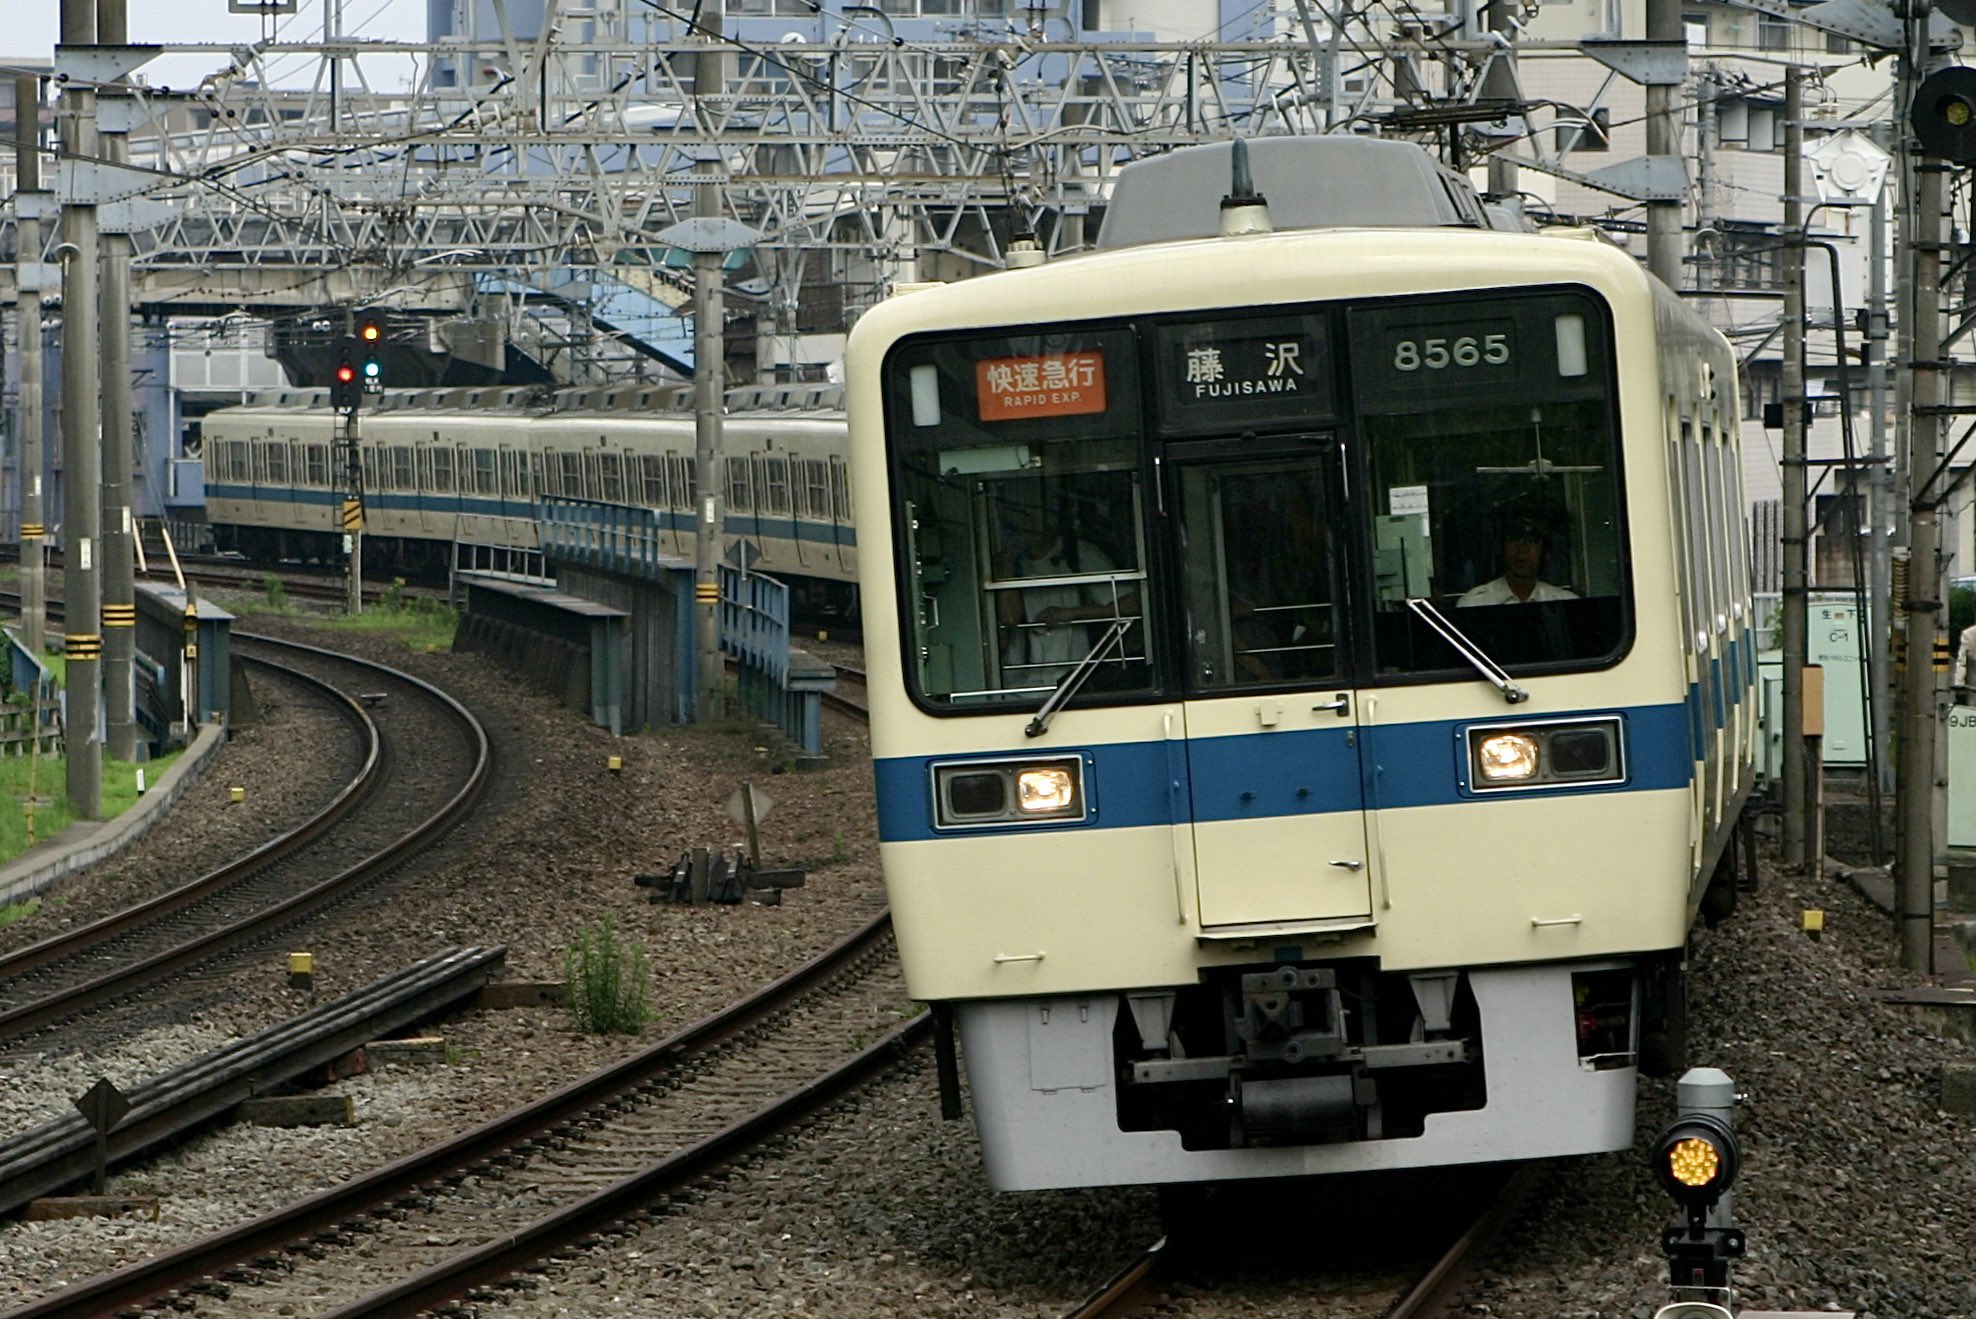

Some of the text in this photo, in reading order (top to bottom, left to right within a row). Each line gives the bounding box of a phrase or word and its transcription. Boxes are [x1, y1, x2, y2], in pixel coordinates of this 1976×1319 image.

[1186, 342, 1304, 383] 藤沢
[1394, 334, 1509, 371] 8565
[987, 359, 1095, 393] 快速急行
[1195, 378, 1298, 398] FUJISAWA
[1004, 391, 1082, 408] RAPID EXP.
